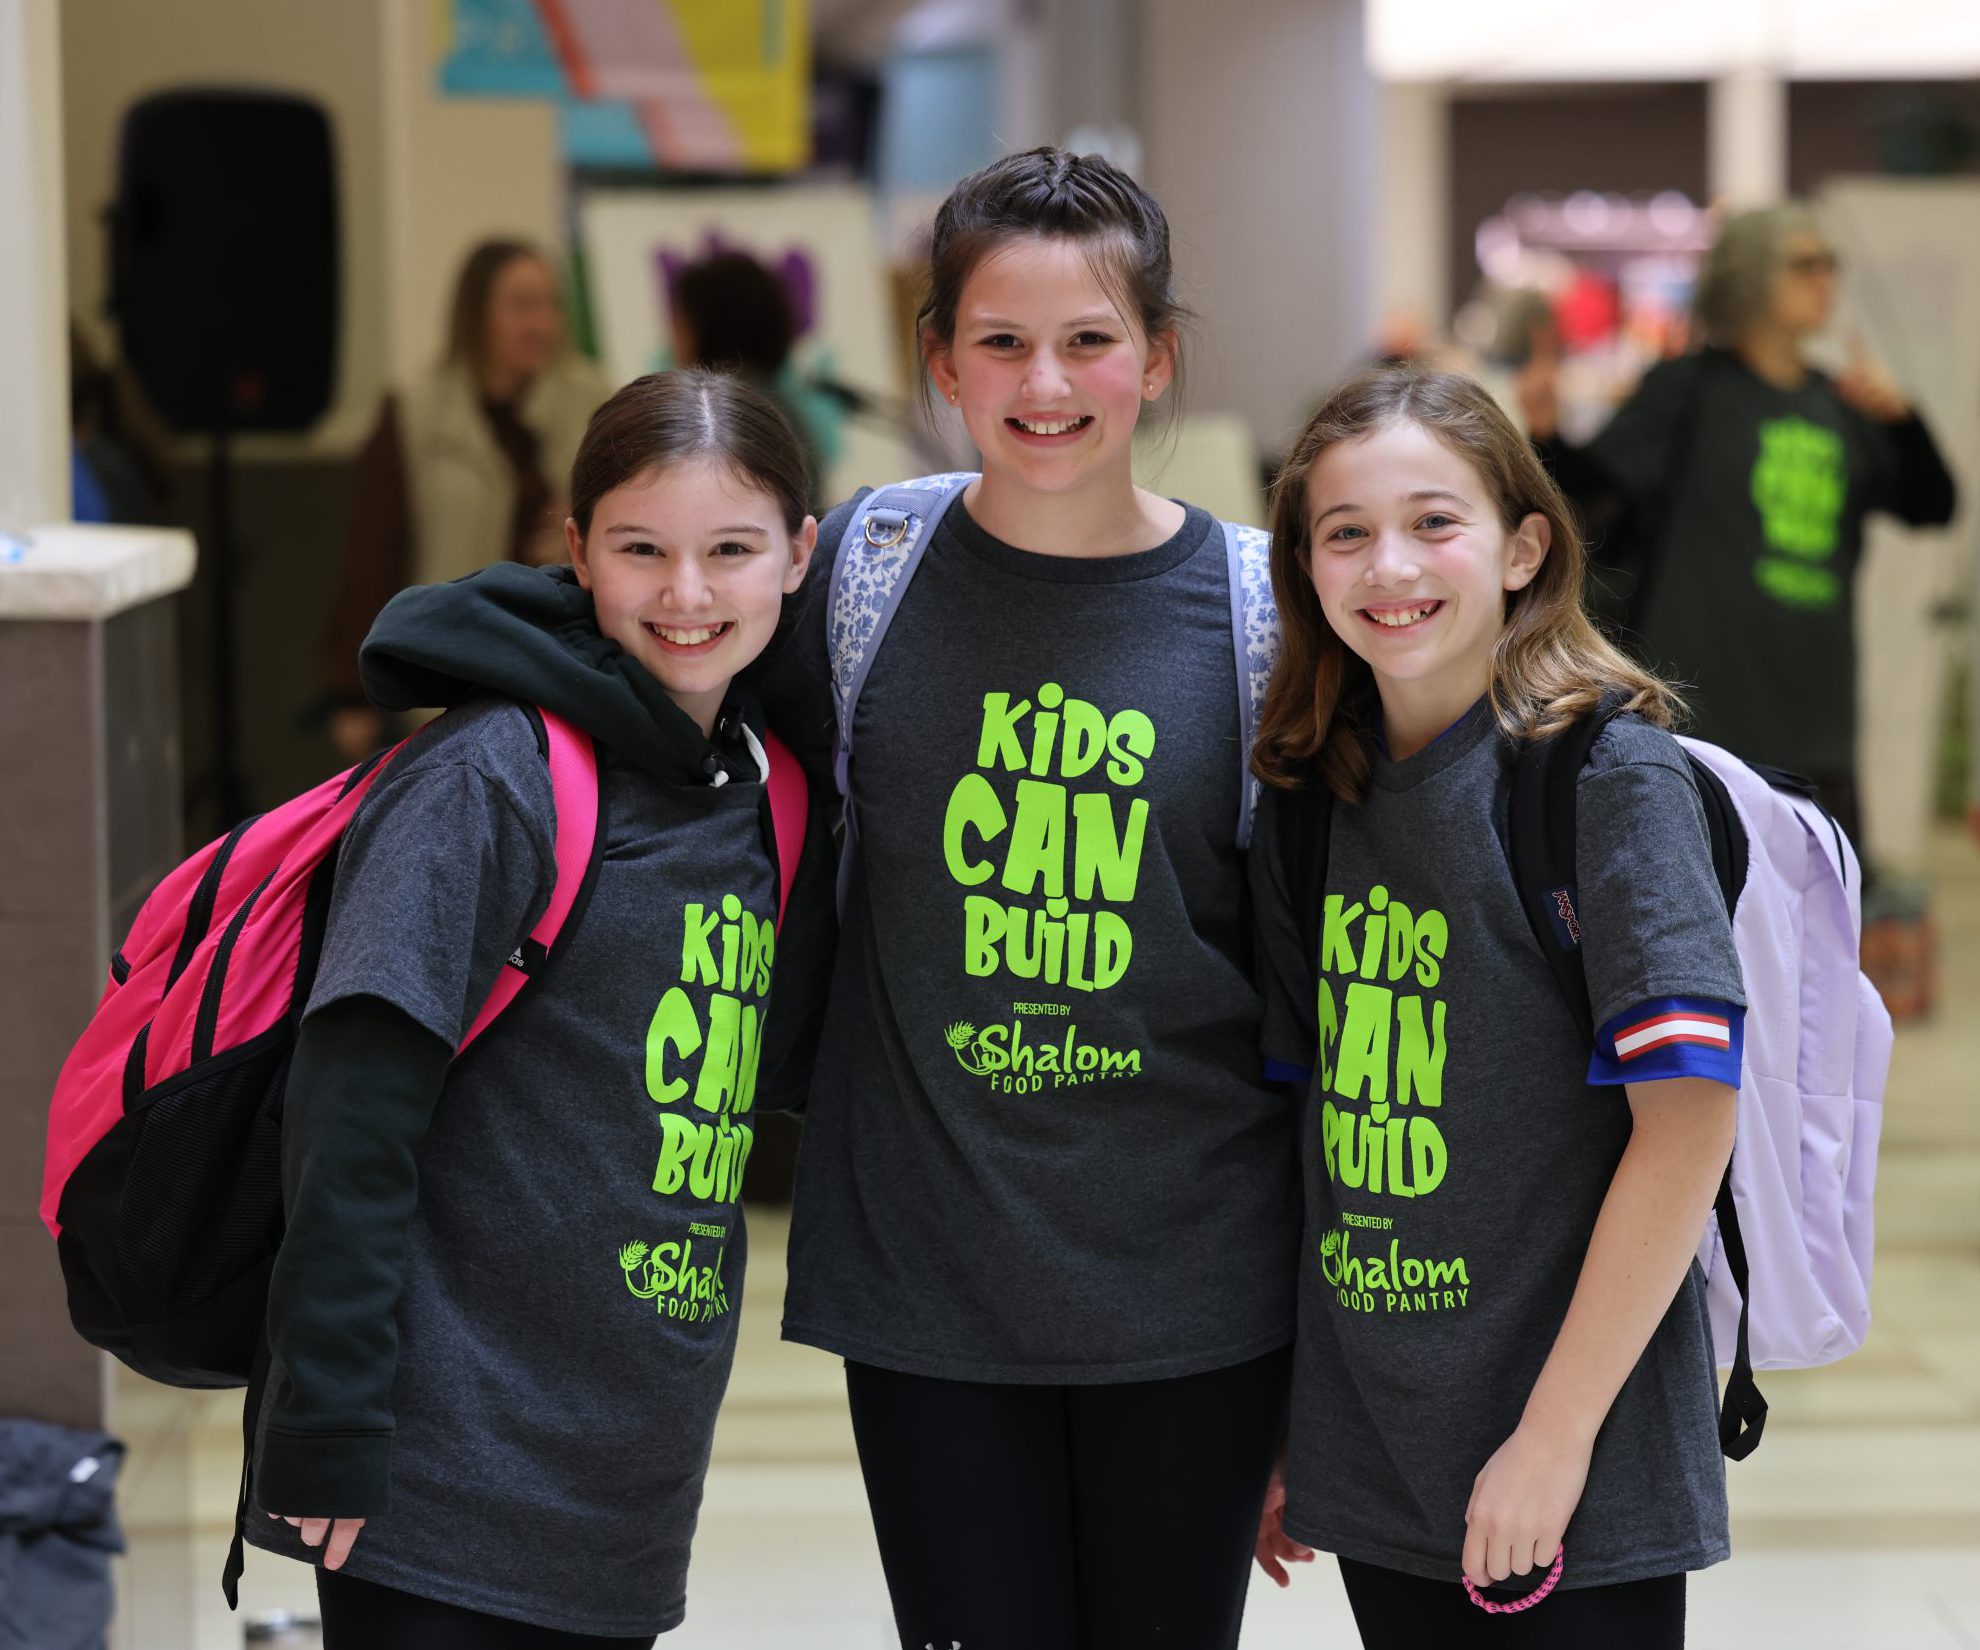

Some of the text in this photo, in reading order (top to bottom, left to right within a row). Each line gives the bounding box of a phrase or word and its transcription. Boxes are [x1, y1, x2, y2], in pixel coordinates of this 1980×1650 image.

[976, 682, 1156, 786] KiDS
[943, 773, 1150, 903] CAN
[680, 893, 775, 997] KiDS
[963, 895, 1133, 993] BUiLD
[1321, 884, 1449, 988] KiDS
[977, 1019, 1142, 1077] Shalom
[1013, 1002, 1071, 1016] PRESENTED BY
[1317, 977, 1448, 1108] CAN
[645, 986, 767, 1114] CAN
[991, 1073, 1043, 1095] FOOD
[1322, 1100, 1448, 1199] BUiLD
[688, 1222, 720, 1238] PRESENTED
[1342, 1212, 1393, 1230] PRESENTED BY
[650, 1238, 724, 1302] Shal
[657, 1294, 699, 1321] FOOD
[1336, 1288, 1469, 1313] OOD PANTRY
